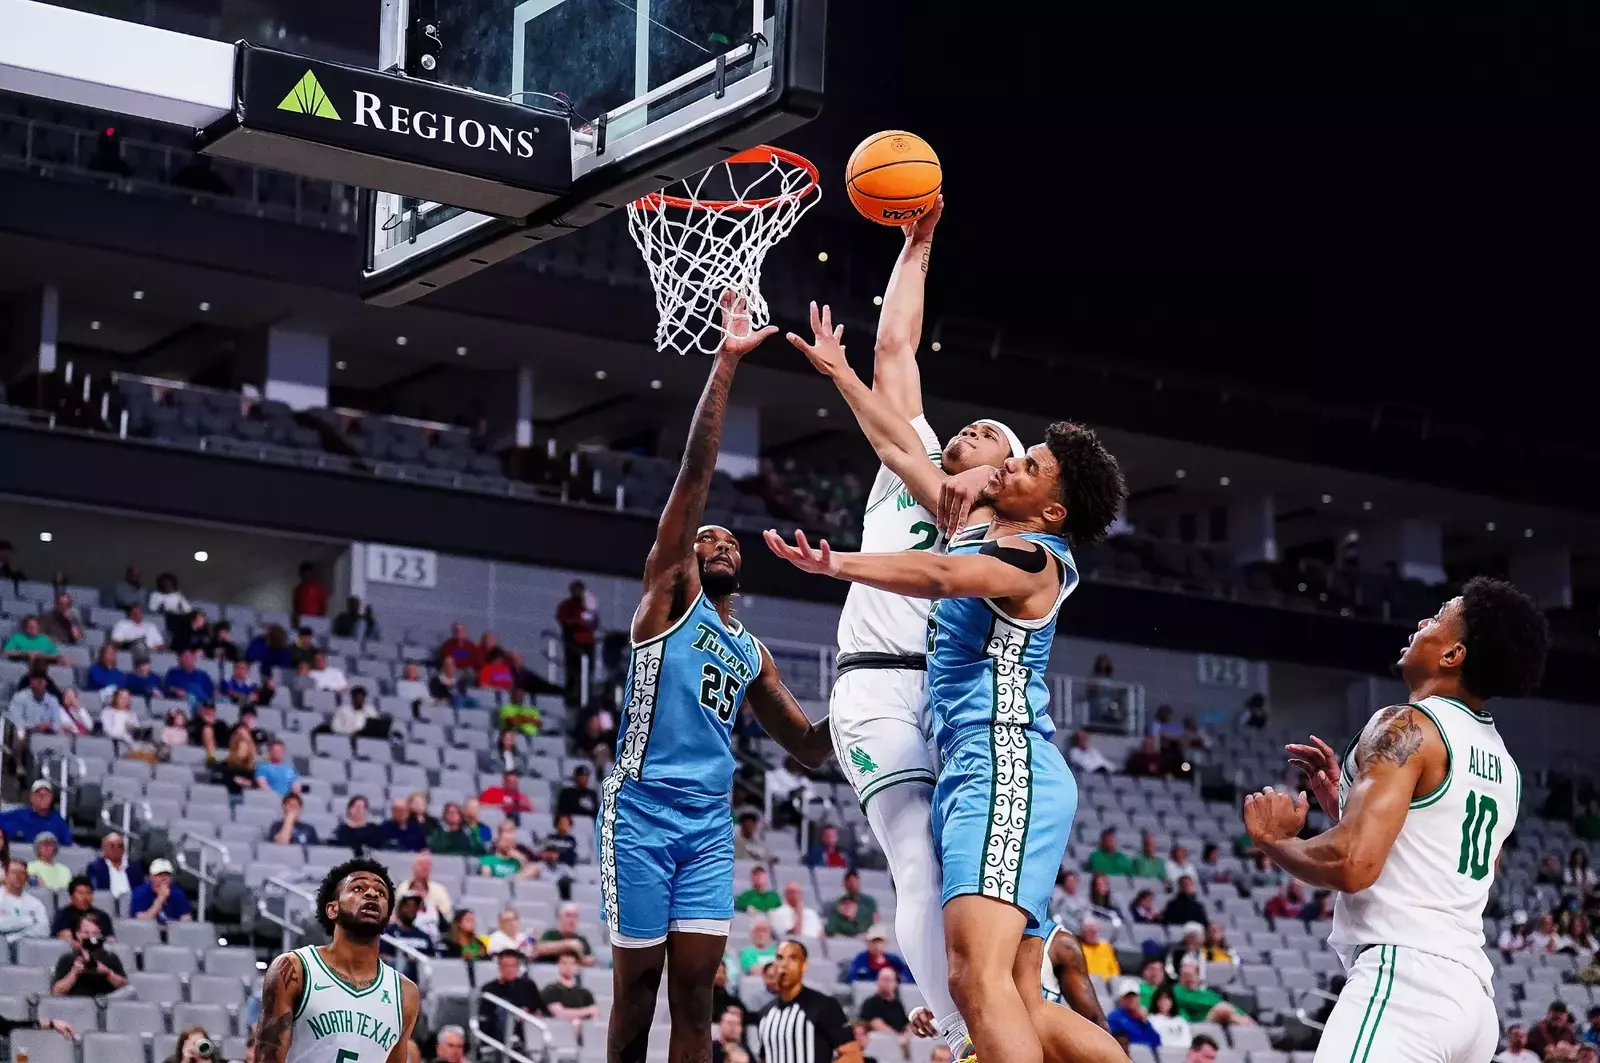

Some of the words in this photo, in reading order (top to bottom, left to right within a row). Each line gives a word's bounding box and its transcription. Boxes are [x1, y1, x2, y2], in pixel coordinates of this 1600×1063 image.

[352, 89, 535, 158] REGIONS
[905, 520, 949, 550] 2
[380, 550, 427, 580] 123
[699, 663, 742, 723] 25
[1468, 745, 1502, 784] ALLEN
[1457, 789, 1499, 881] 10
[306, 1010, 353, 1040] NORTH
[356, 1012, 397, 1051] TEXAS
